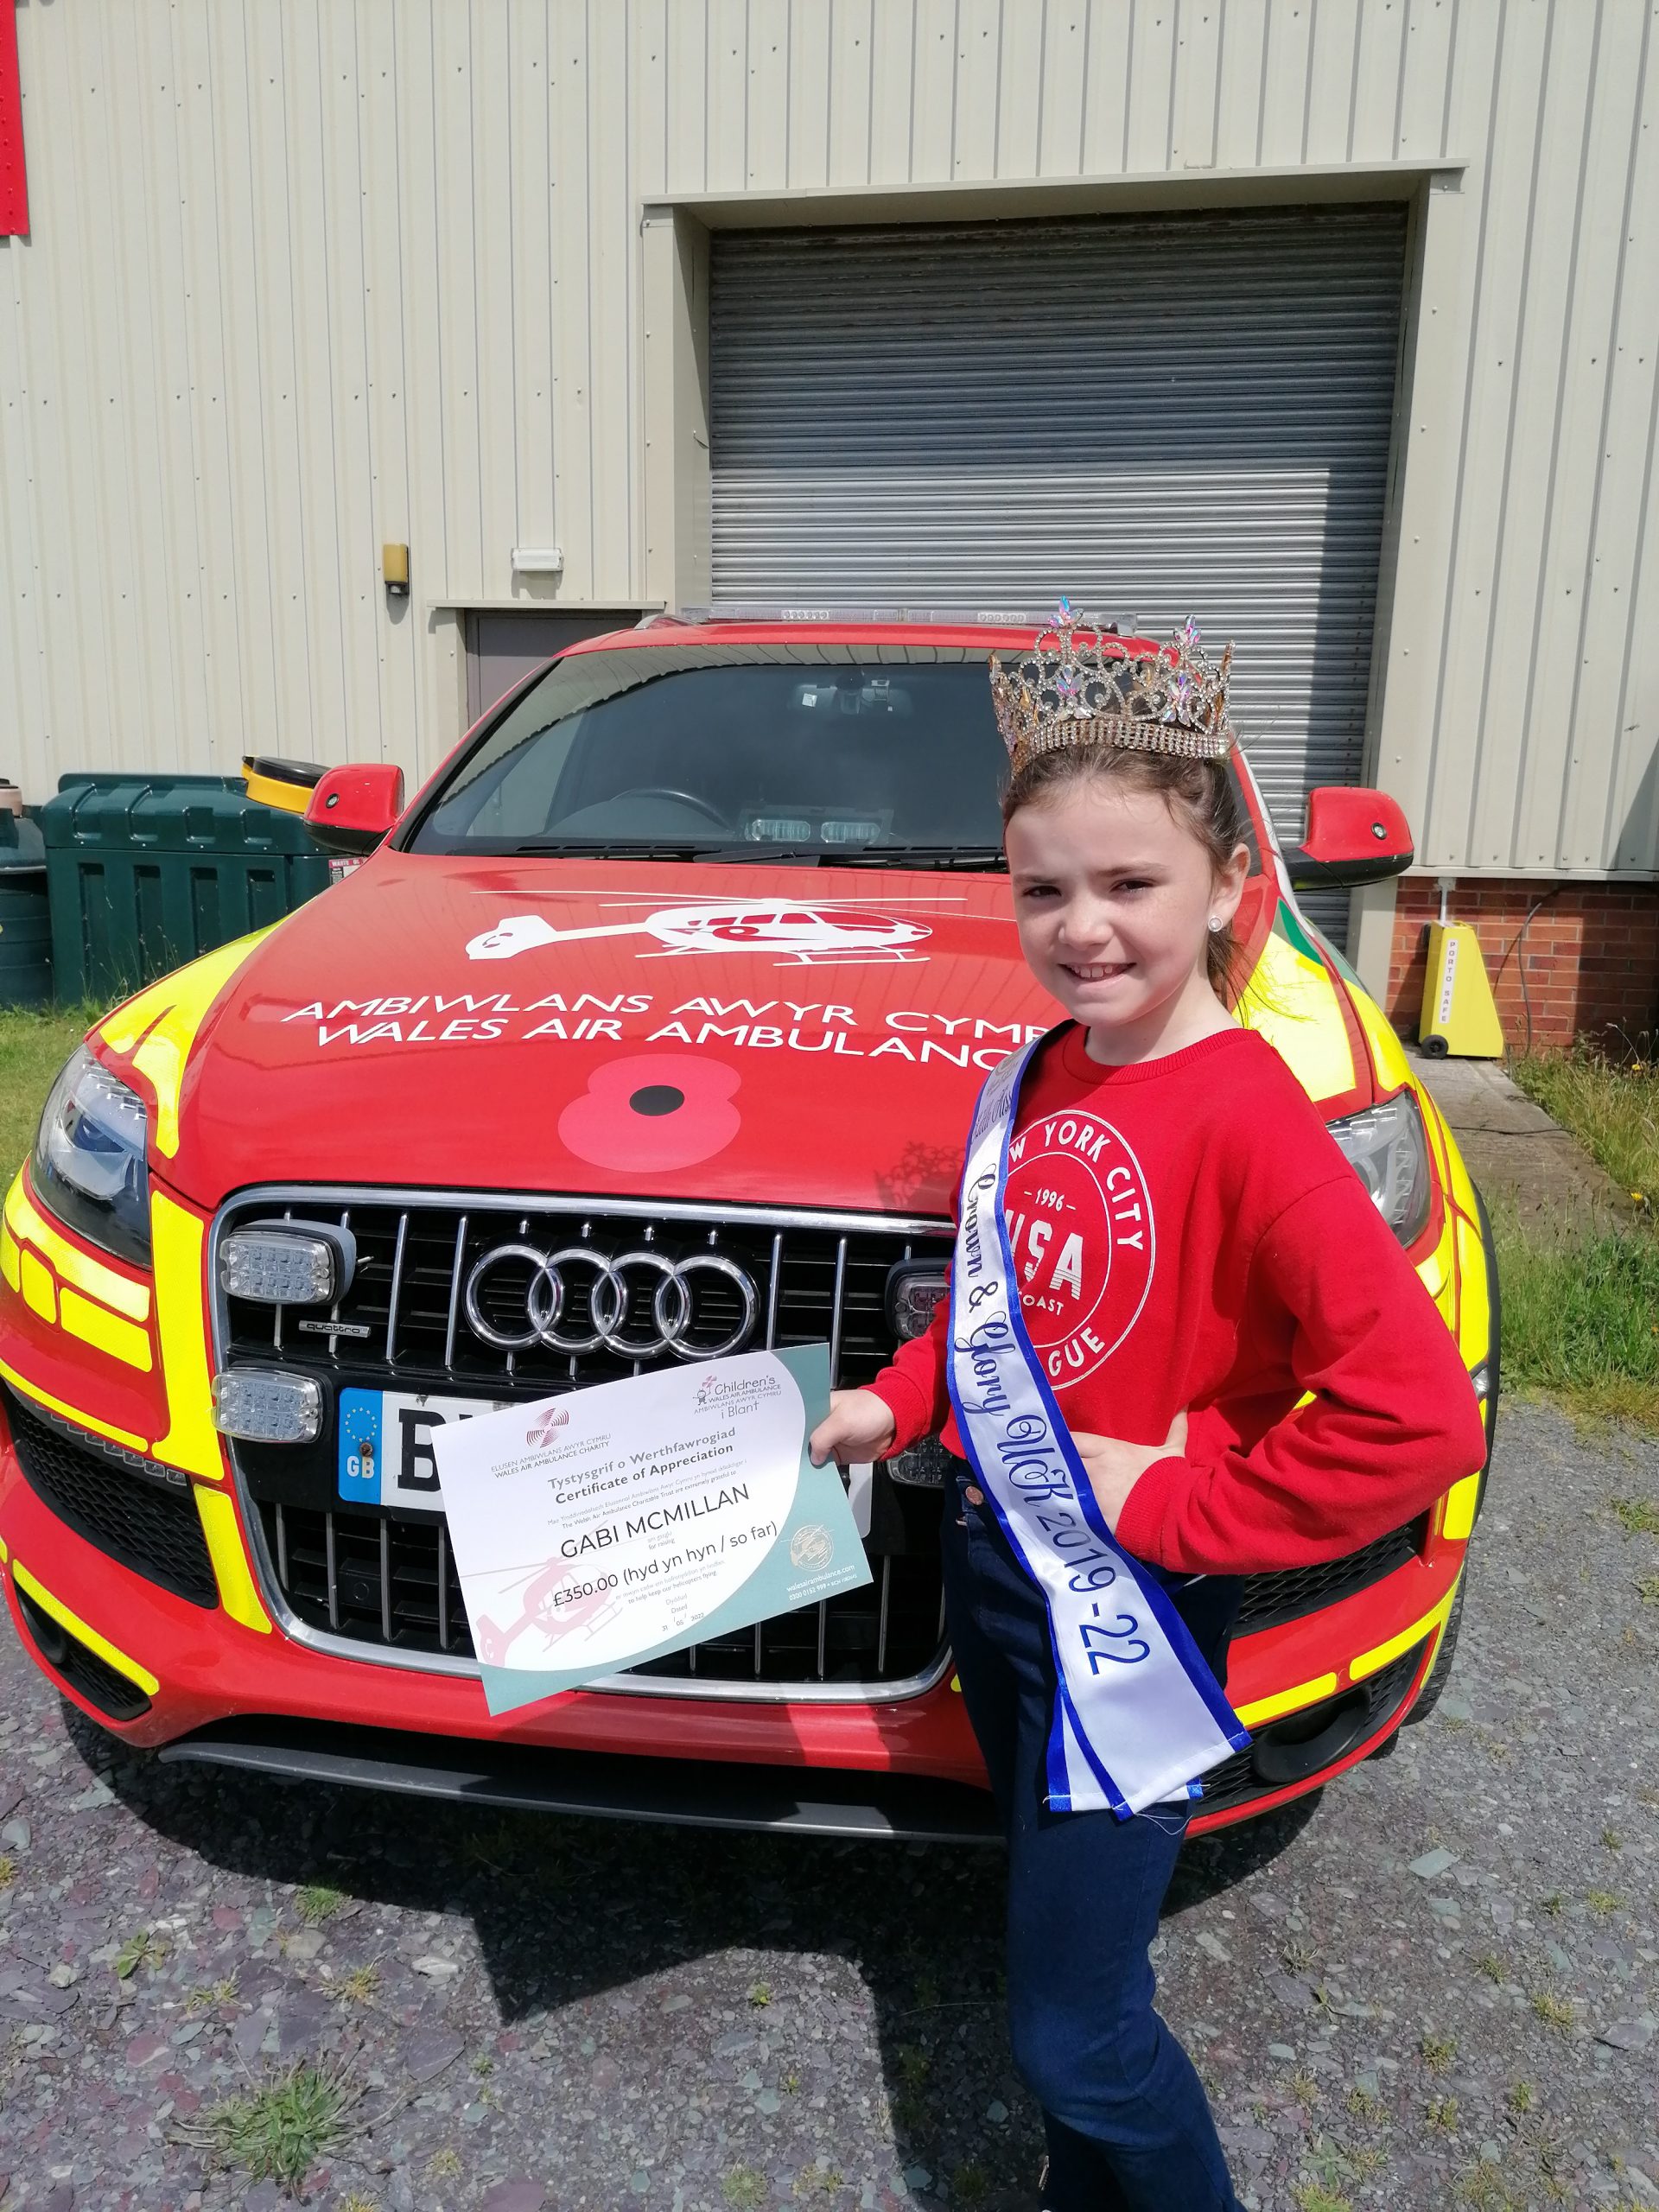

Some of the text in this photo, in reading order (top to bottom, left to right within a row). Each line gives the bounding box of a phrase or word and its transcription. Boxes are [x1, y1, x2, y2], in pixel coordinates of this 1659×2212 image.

[1446, 942, 1455, 982] PORTO
[281, 994, 1050, 1045] AMBIWLANS AWYR CYMR
[1441, 990, 1450, 1021] SAFE
[319, 1018, 509, 1046] WALES
[521, 1018, 623, 1040] AIR
[645, 1021, 1014, 1071] AMBULANC
[1009, 1120, 1143, 1250] W YORK CITY
[1035, 1188, 1064, 1212] 1996
[966, 1163, 997, 1278] Crown
[969, 1281, 999, 1313] &
[1018, 1289, 1065, 1316] OAST
[306, 1322, 362, 1334] quattro
[954, 1311, 1016, 1416] Glory
[1048, 1326, 1106, 1377] GUE
[694, 1400, 734, 1414] AMBIWLANS
[757, 1389, 782, 1400] CYMRU
[709, 1384, 781, 1403] WALES AIR AMBULANCE
[715, 1375, 776, 1395] Children's
[728, 1399, 760, 1418] Blant
[346, 1455, 376, 1480] GB
[491, 1433, 612, 1472] ELUSEN AMBIWLANS AWYR CYMRU
[494, 1466, 519, 1479] WALES
[534, 1450, 578, 1468] AMBULANCE
[579, 1440, 610, 1454] CHARITY
[548, 1427, 736, 1491] Tystysgrif o Werthfawrogiad
[996, 1414, 1073, 1507] UK
[556, 1445, 734, 1504] Certificate of Appreciation
[602, 1503, 632, 1517] Ambulance
[660, 1489, 675, 1499] Trust
[684, 1477, 711, 1491] extremely
[710, 1471, 732, 1484] grateful
[561, 1483, 751, 1559] GABI MCMILLAN
[553, 1520, 779, 1607] £350.00 (hyd yn hyn / so far)
[1036, 1512, 1116, 1592] 2019
[635, 1592, 648, 1602] help
[648, 1588, 663, 1599] keep
[672, 1573, 703, 1590] helicopters
[786, 1564, 855, 1593] walesairambulance.com
[789, 1592, 804, 1601] 0300
[803, 1586, 817, 1597] 0152
[671, 1604, 689, 1614] Dated
[690, 1612, 705, 1622] 2022
[1078, 1614, 1151, 1675] 22
